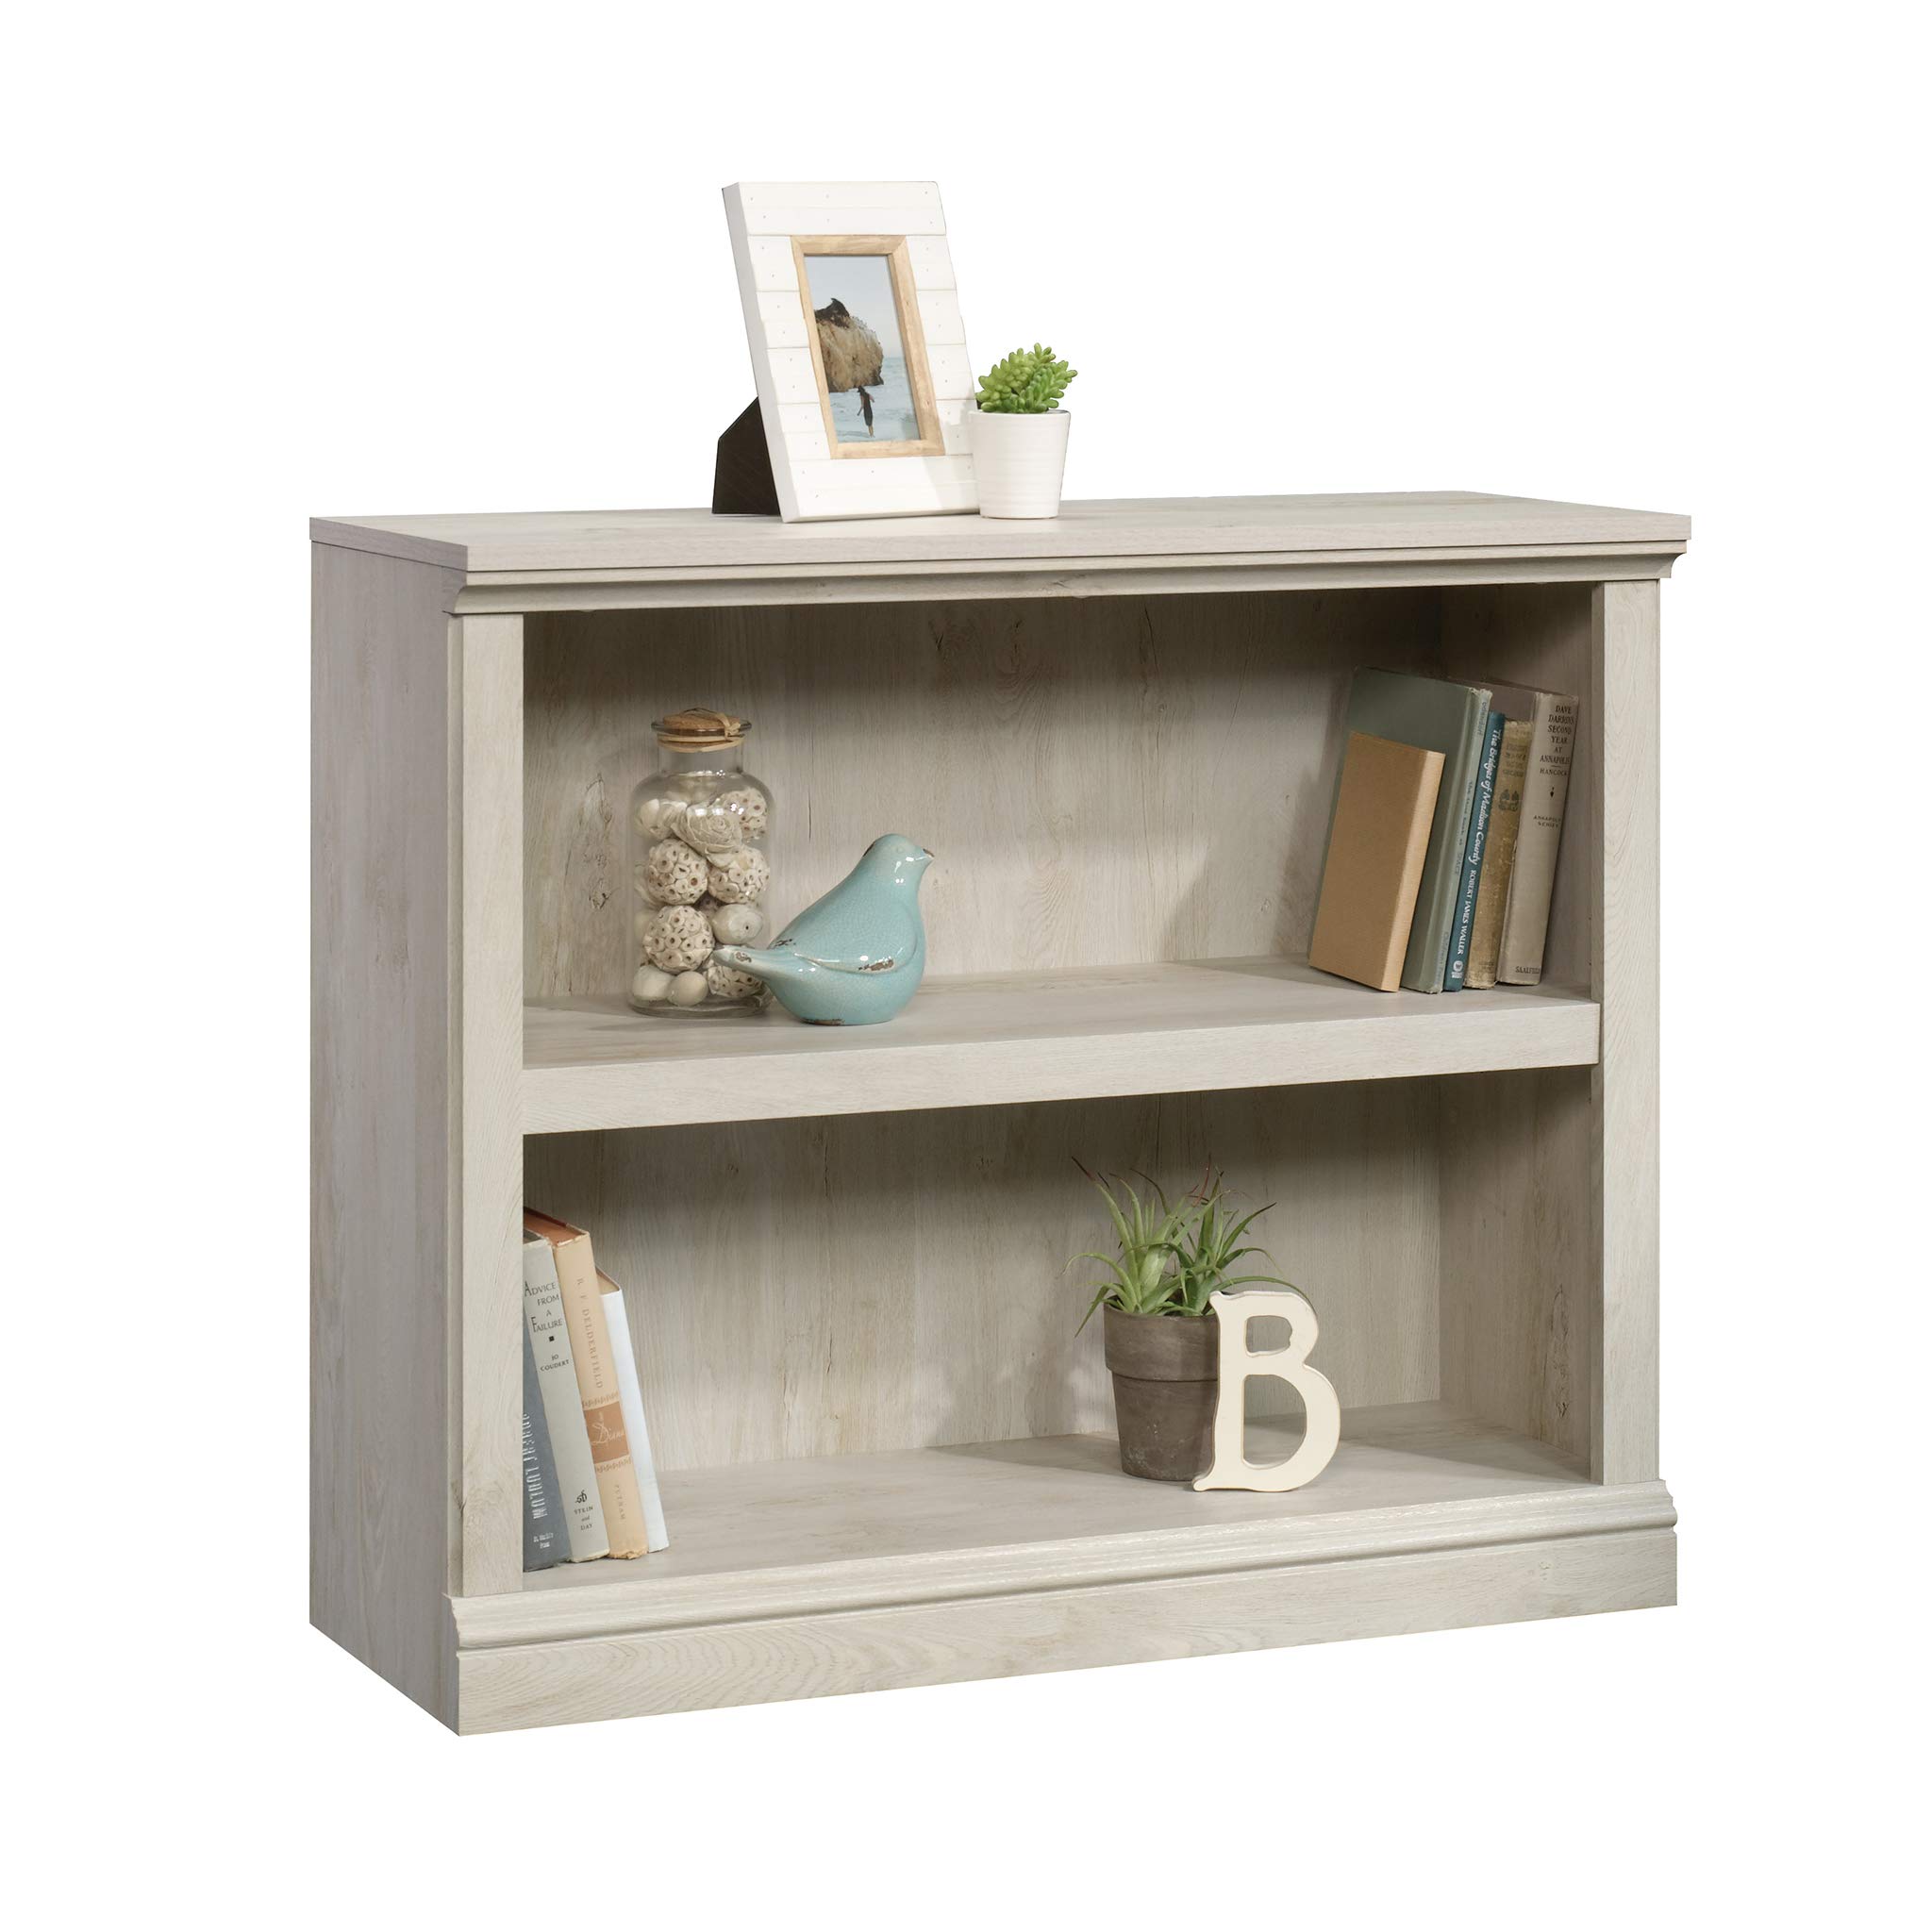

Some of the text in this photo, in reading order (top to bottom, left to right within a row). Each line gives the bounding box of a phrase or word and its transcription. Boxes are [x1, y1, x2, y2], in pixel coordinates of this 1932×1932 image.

[1555, 705, 1572, 714] DAVE
[1548, 724, 1572, 735] SECOND
[1551, 736, 1568, 744] YEAR
[1457, 729, 1502, 955] The Bridges of Madison County ROBERT JAMES WALLER
[524, 1280, 556, 1296] ADVICE
[538, 1294, 559, 1306] FROM
[531, 1316, 563, 1332] FAILURE
[540, 1359, 570, 1372] COUDERT
[1192, 1291, 1341, 1492] B
[525, 1467, 548, 1519] LUDLUM
[575, 1506, 593, 1514] STEIN
